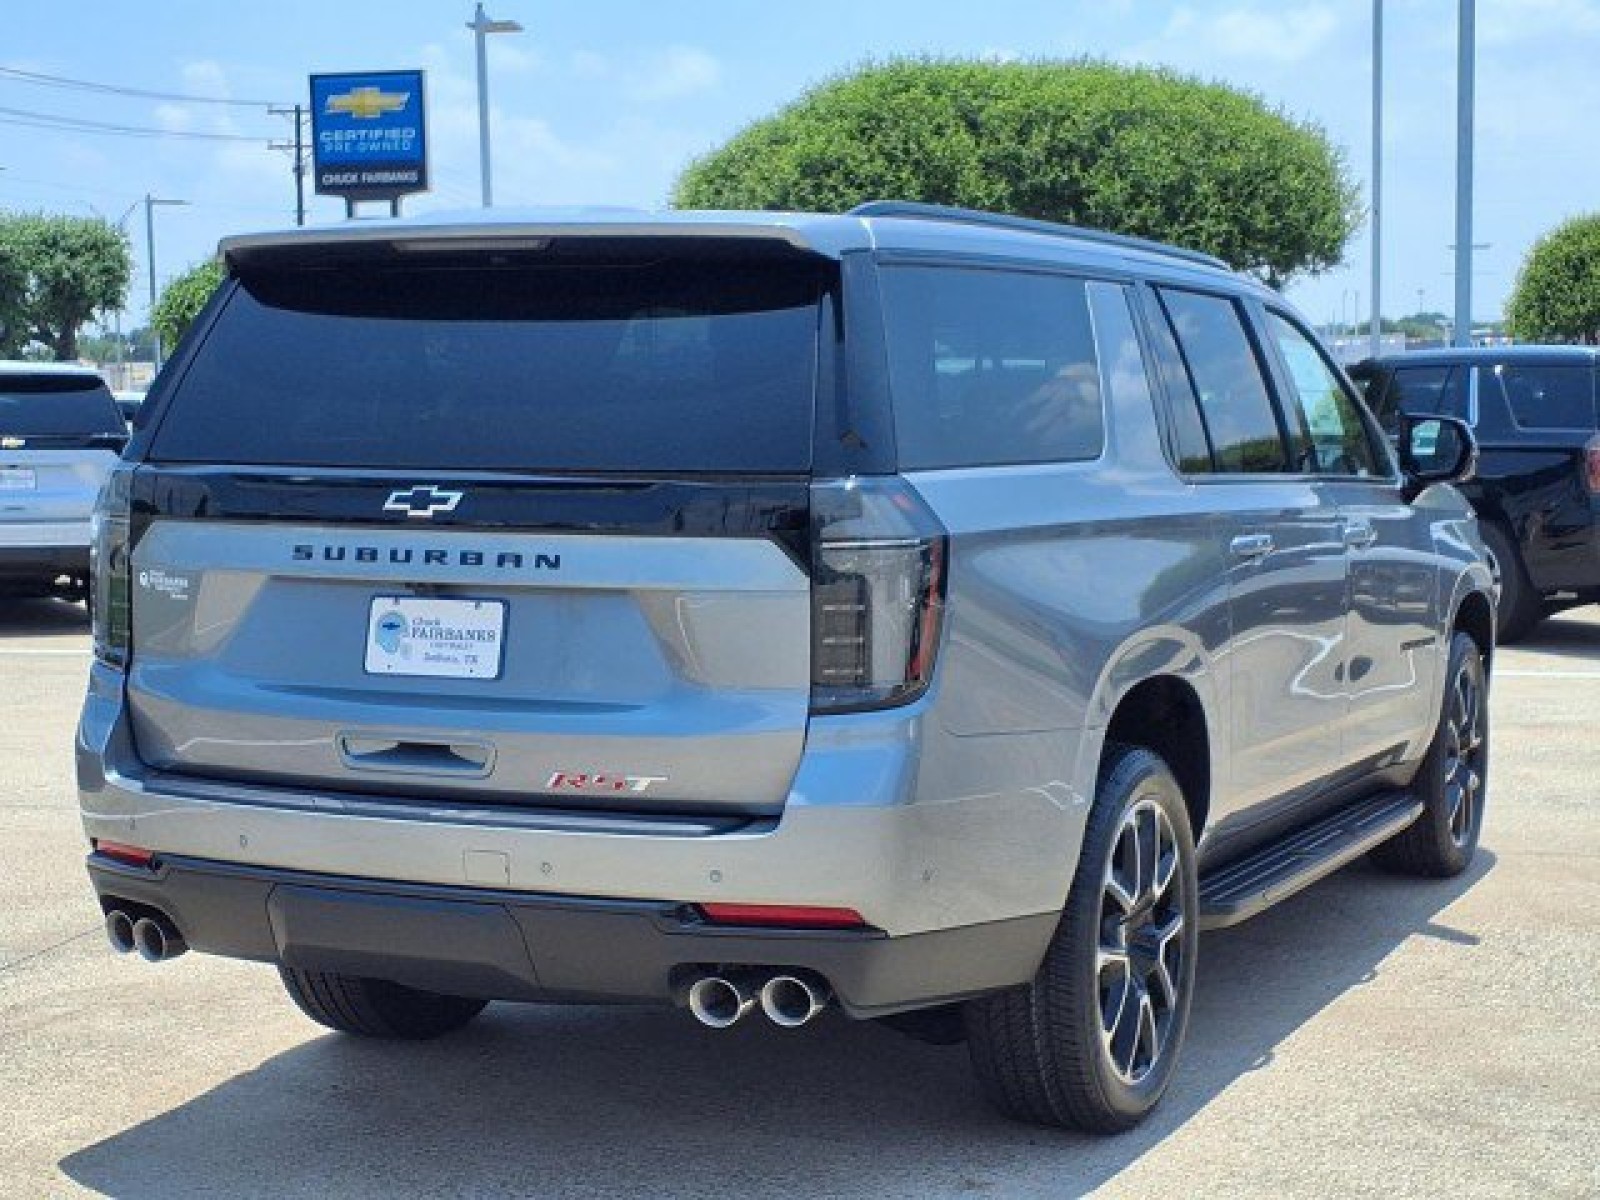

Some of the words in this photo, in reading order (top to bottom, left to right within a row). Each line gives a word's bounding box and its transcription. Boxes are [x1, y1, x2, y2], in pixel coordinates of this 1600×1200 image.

[320, 128, 416, 140] CERTIFIED
[321, 173, 359, 185] CHUCK
[362, 171, 418, 183] FAIRBANKS
[292, 544, 560, 570] SUBURBAN
[411, 627, 496, 642] FAIRBANKS
[545, 771, 668, 791] RST
